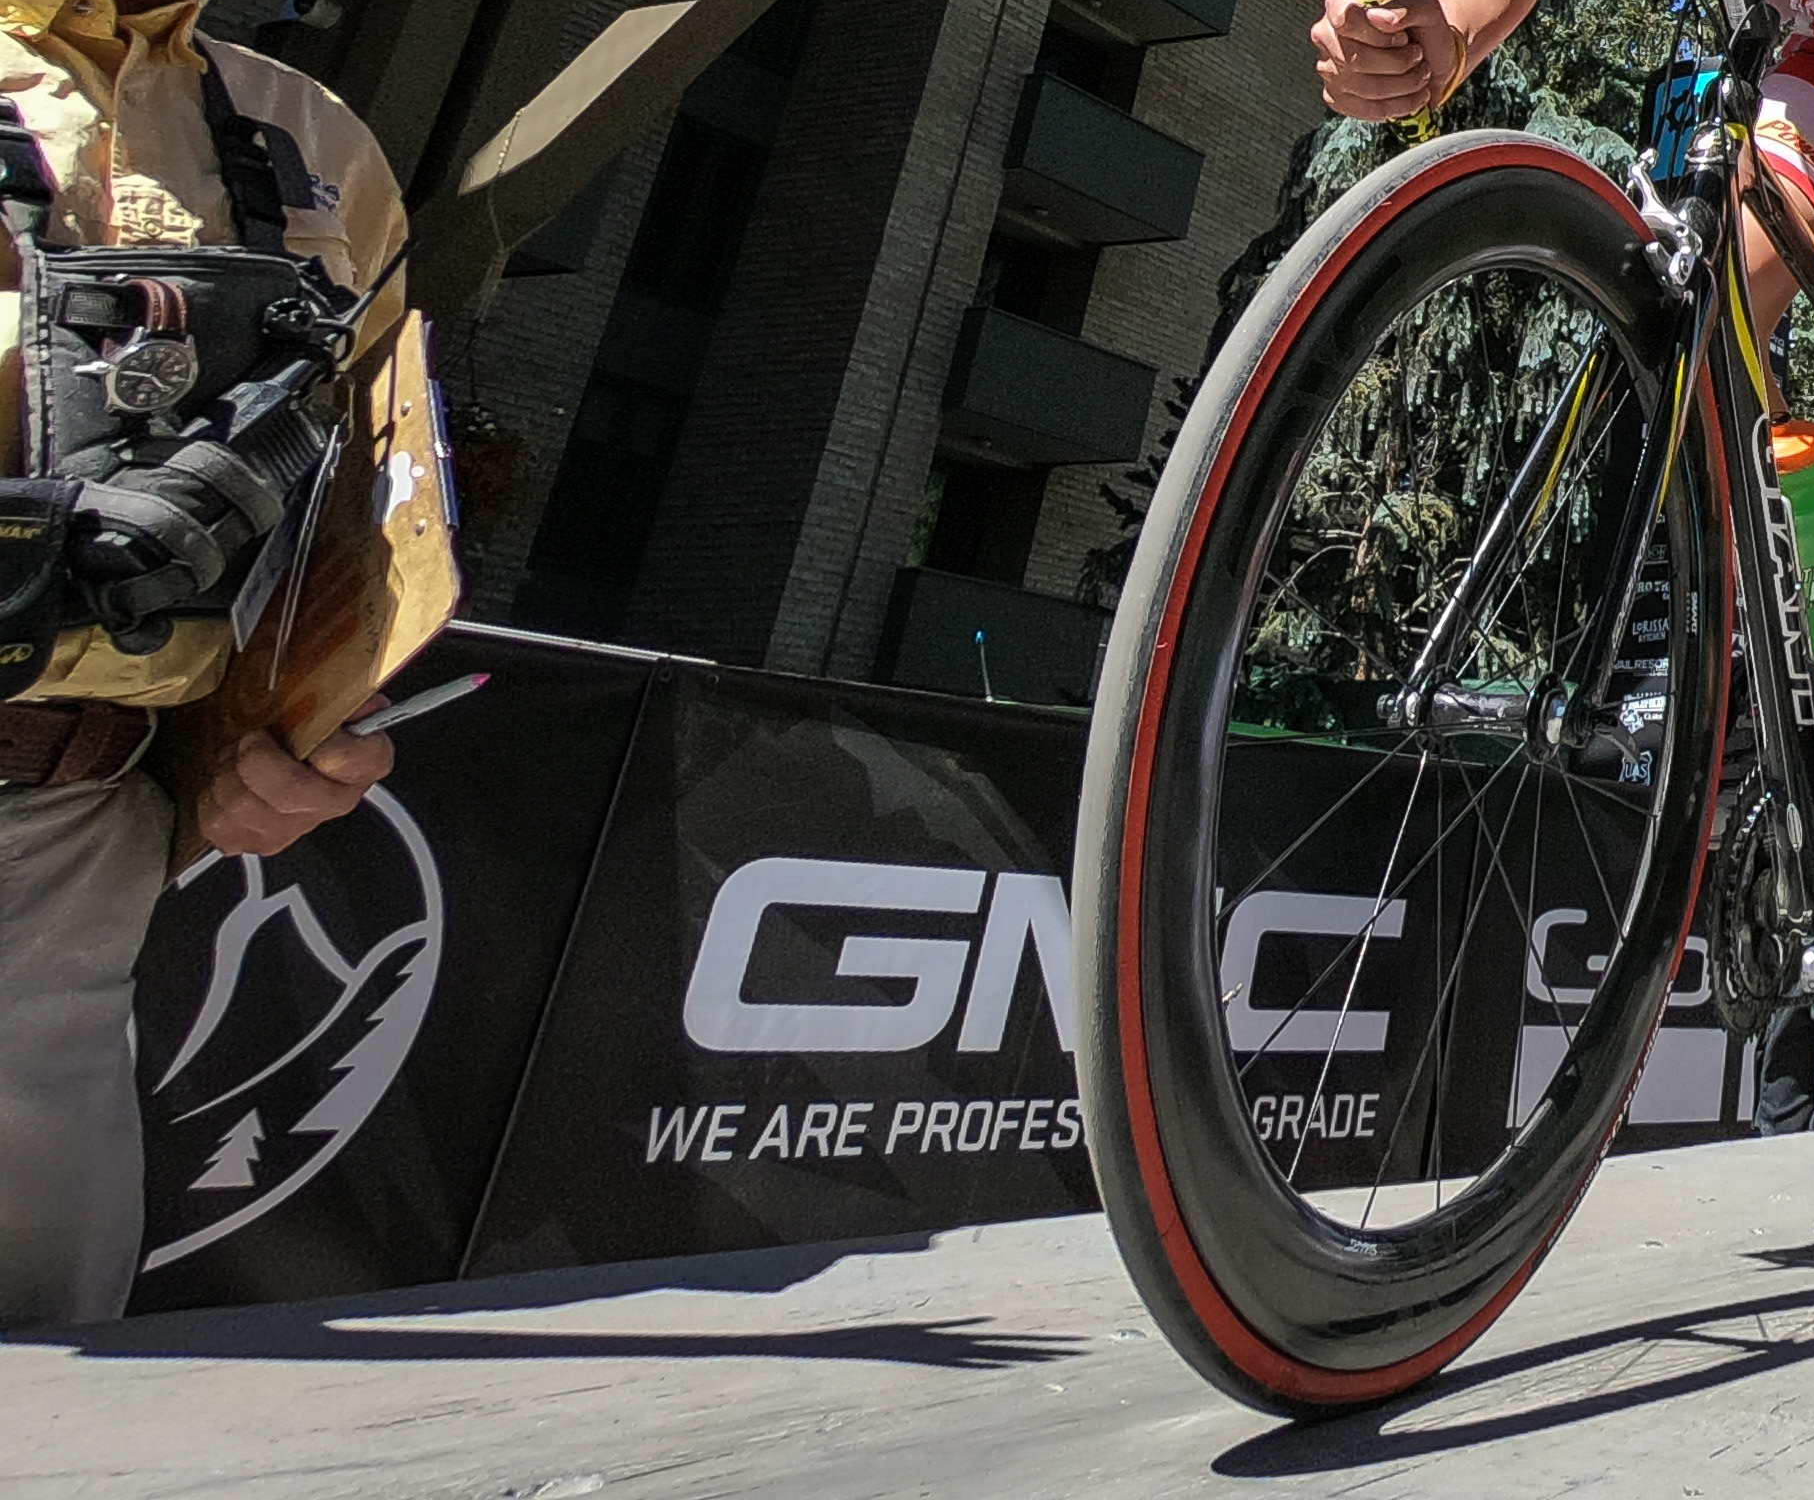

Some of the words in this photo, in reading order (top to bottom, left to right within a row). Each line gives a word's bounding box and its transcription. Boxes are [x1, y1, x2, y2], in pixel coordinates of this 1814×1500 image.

[645, 1104, 744, 1164] WE
[749, 1103, 874, 1160] ARE
[886, 1099, 1091, 1155] PROFES
[1253, 1093, 1380, 1141] GRADE
